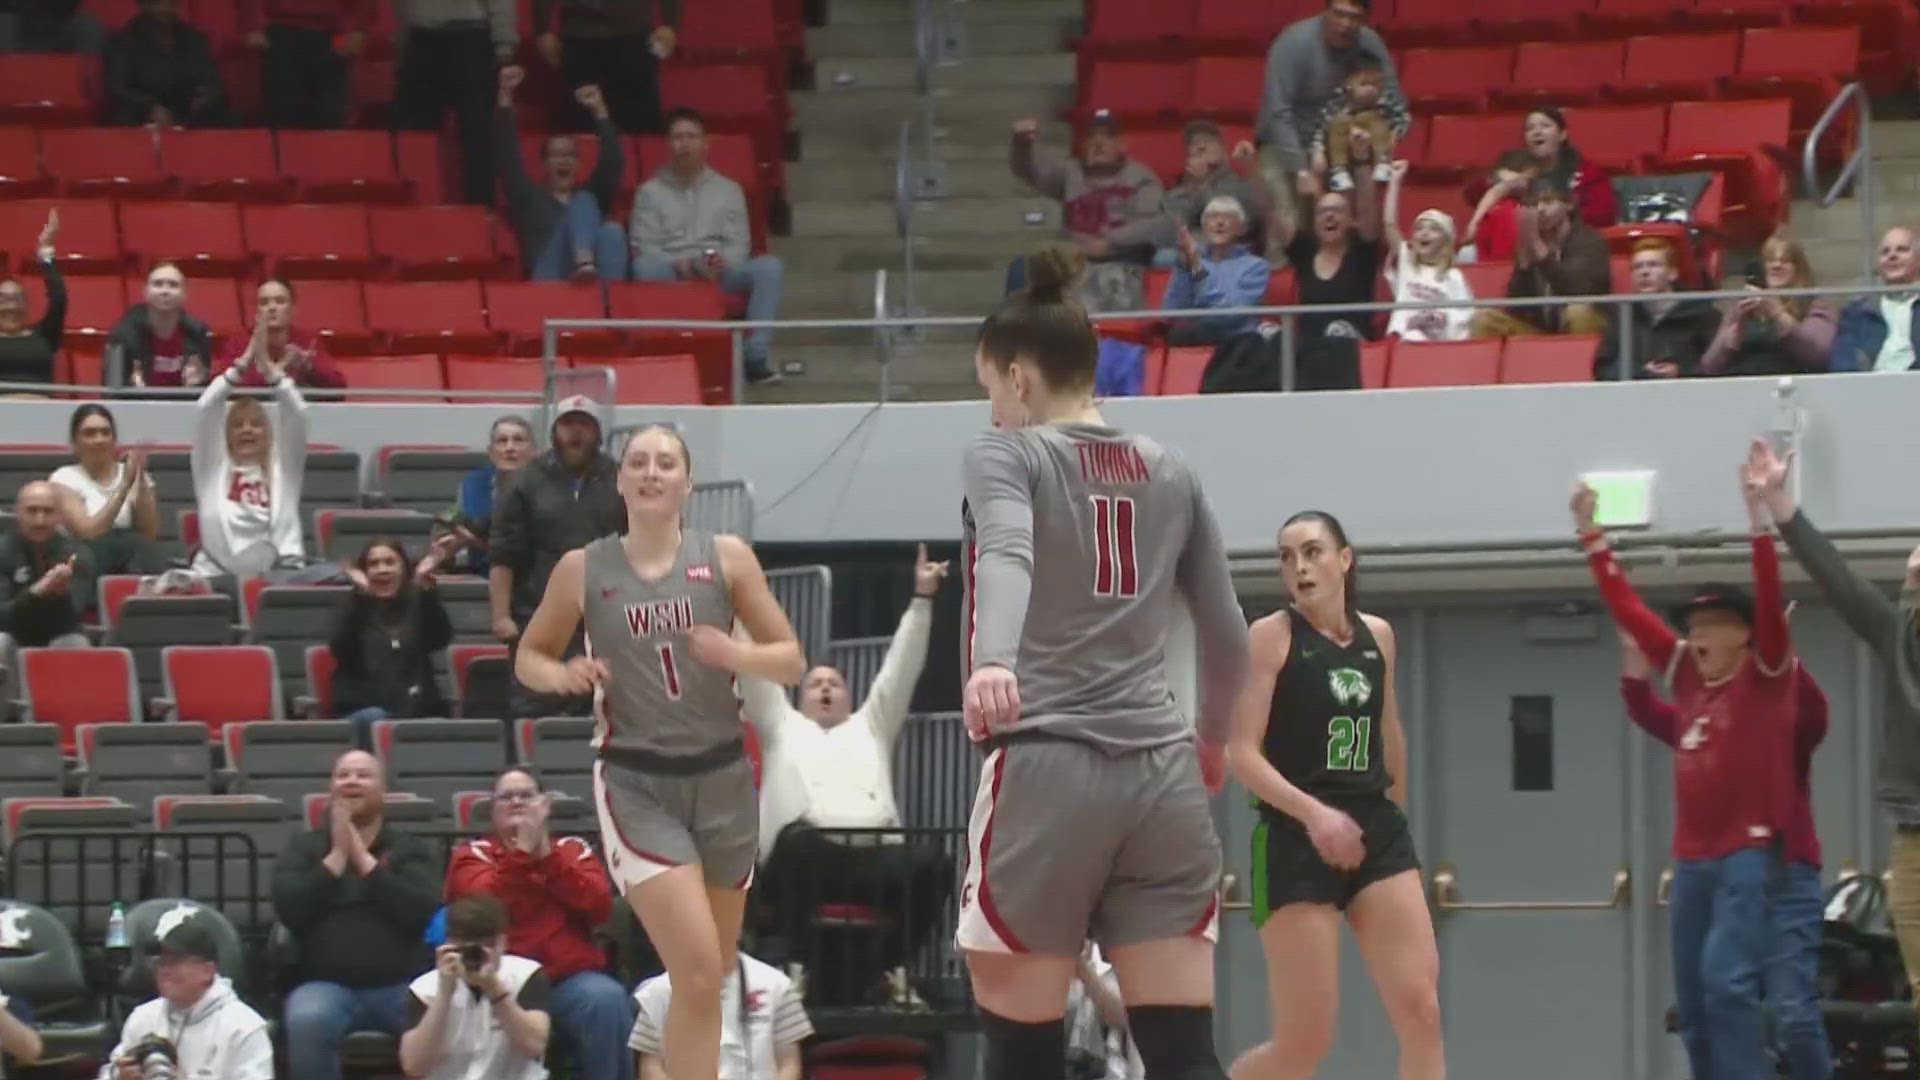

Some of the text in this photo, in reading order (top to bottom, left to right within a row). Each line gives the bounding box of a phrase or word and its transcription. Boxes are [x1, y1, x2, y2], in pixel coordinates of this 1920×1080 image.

[1089, 495, 1138, 598] 11
[624, 595, 694, 640] WSU
[655, 642, 681, 700] 1
[1327, 715, 1370, 771] 21
